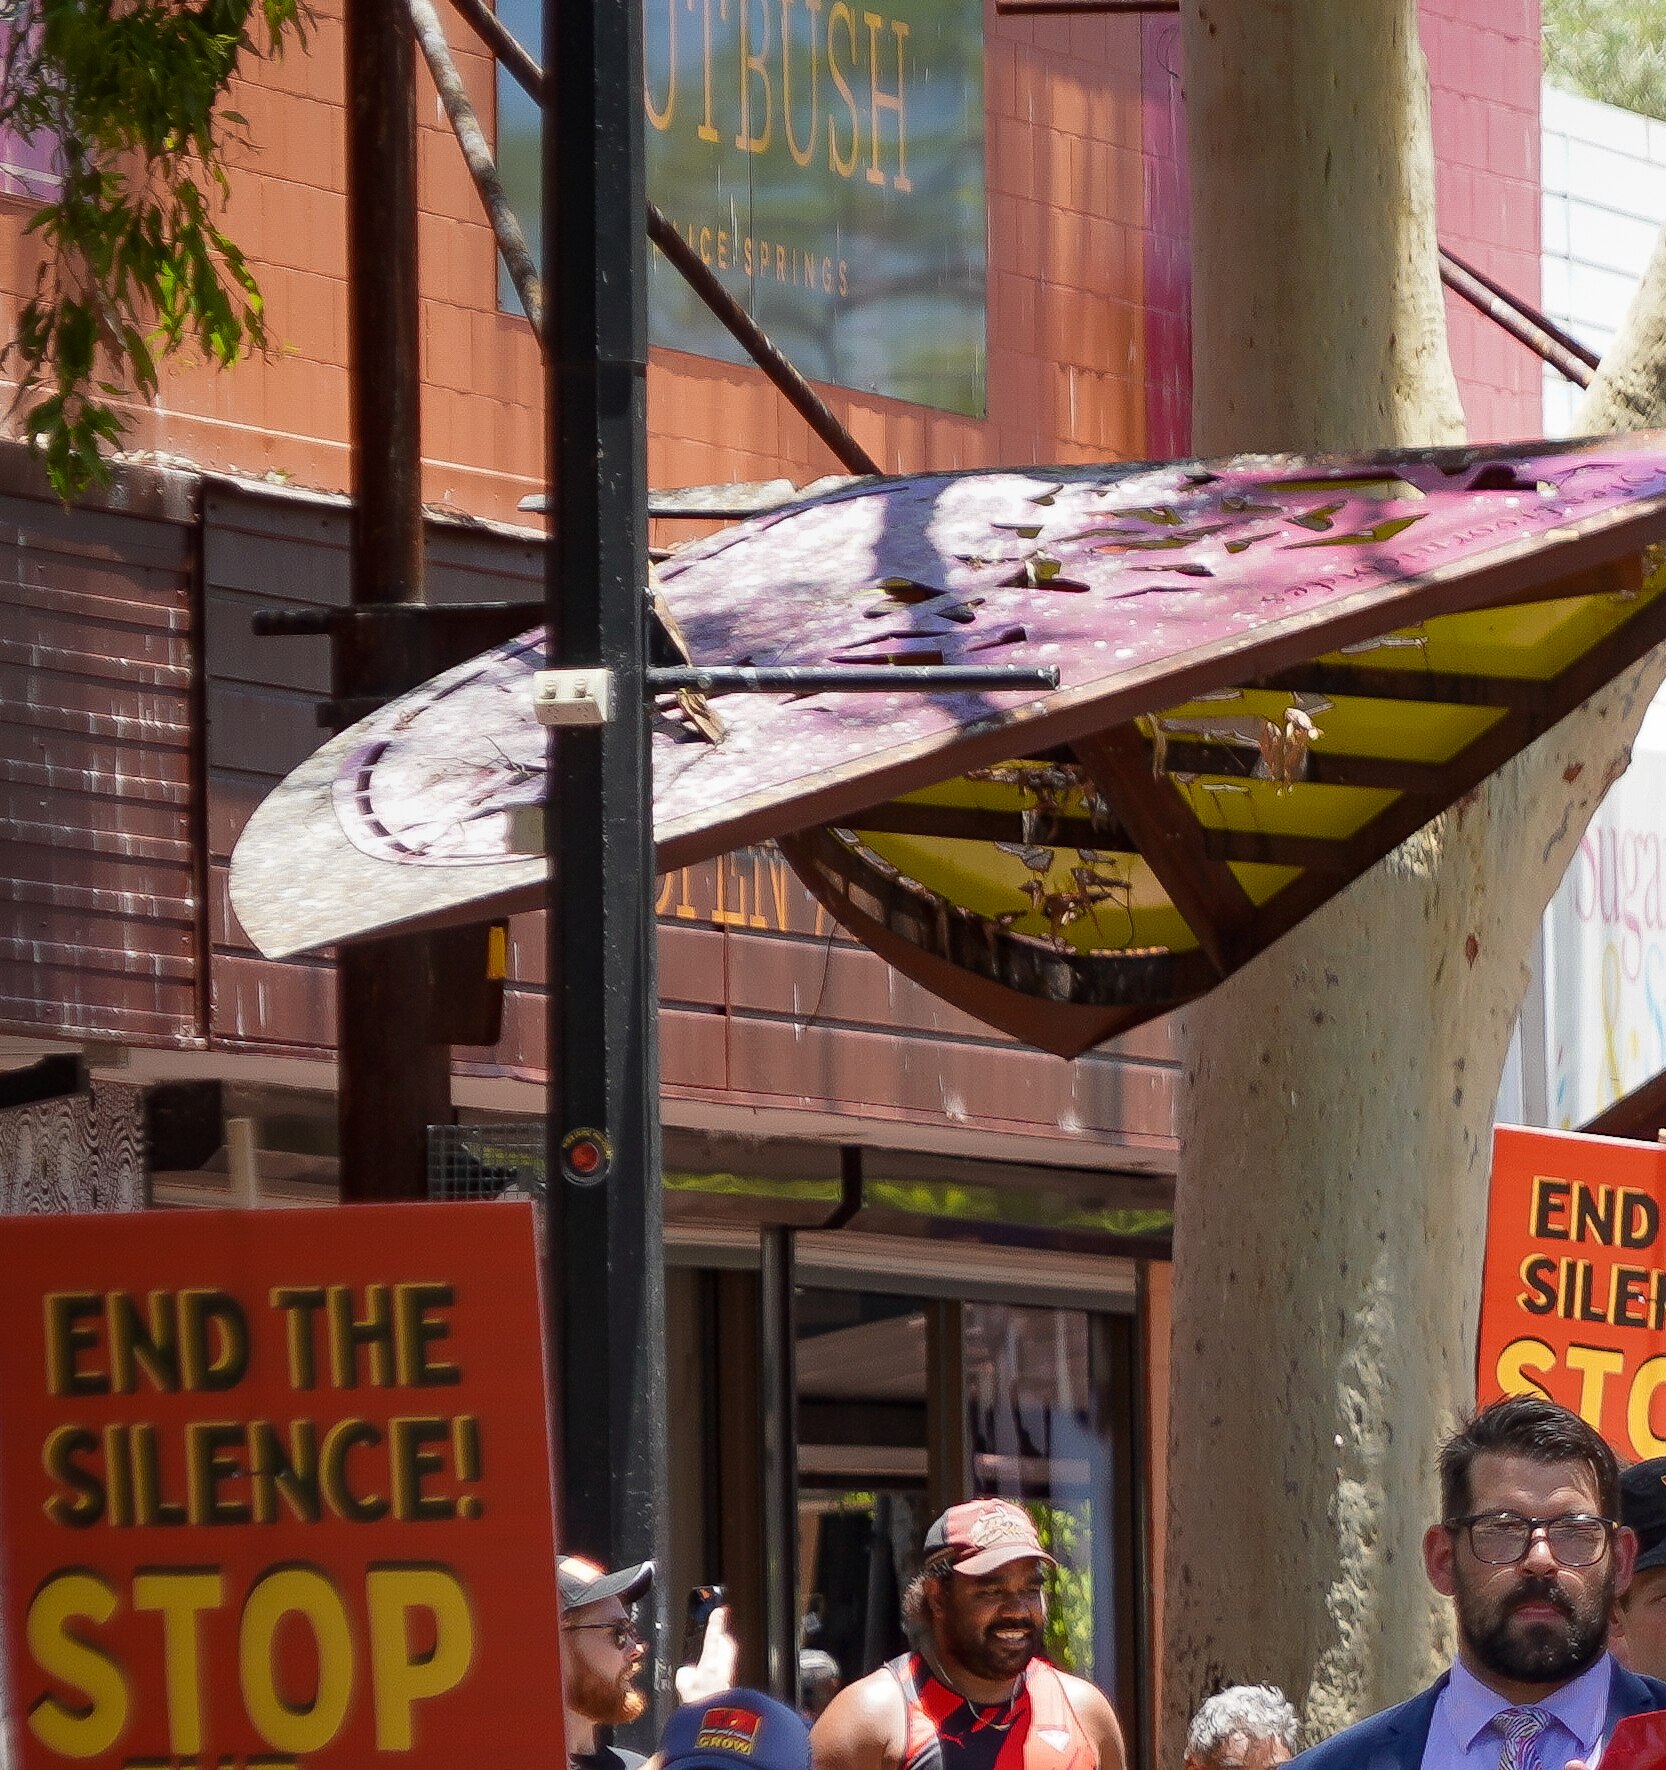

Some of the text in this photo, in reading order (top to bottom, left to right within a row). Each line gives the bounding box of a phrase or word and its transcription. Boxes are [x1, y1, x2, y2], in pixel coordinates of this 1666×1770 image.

[643, 0, 912, 192] UTBUSH
[744, 236, 849, 298] SPRINGS
[1530, 1175, 1659, 1249] END
[42, 1281, 463, 1395] END THE
[41, 1414, 485, 1528] SILENCE!
[27, 1560, 476, 1758] STOP
[699, 1736, 752, 1755] GROW
